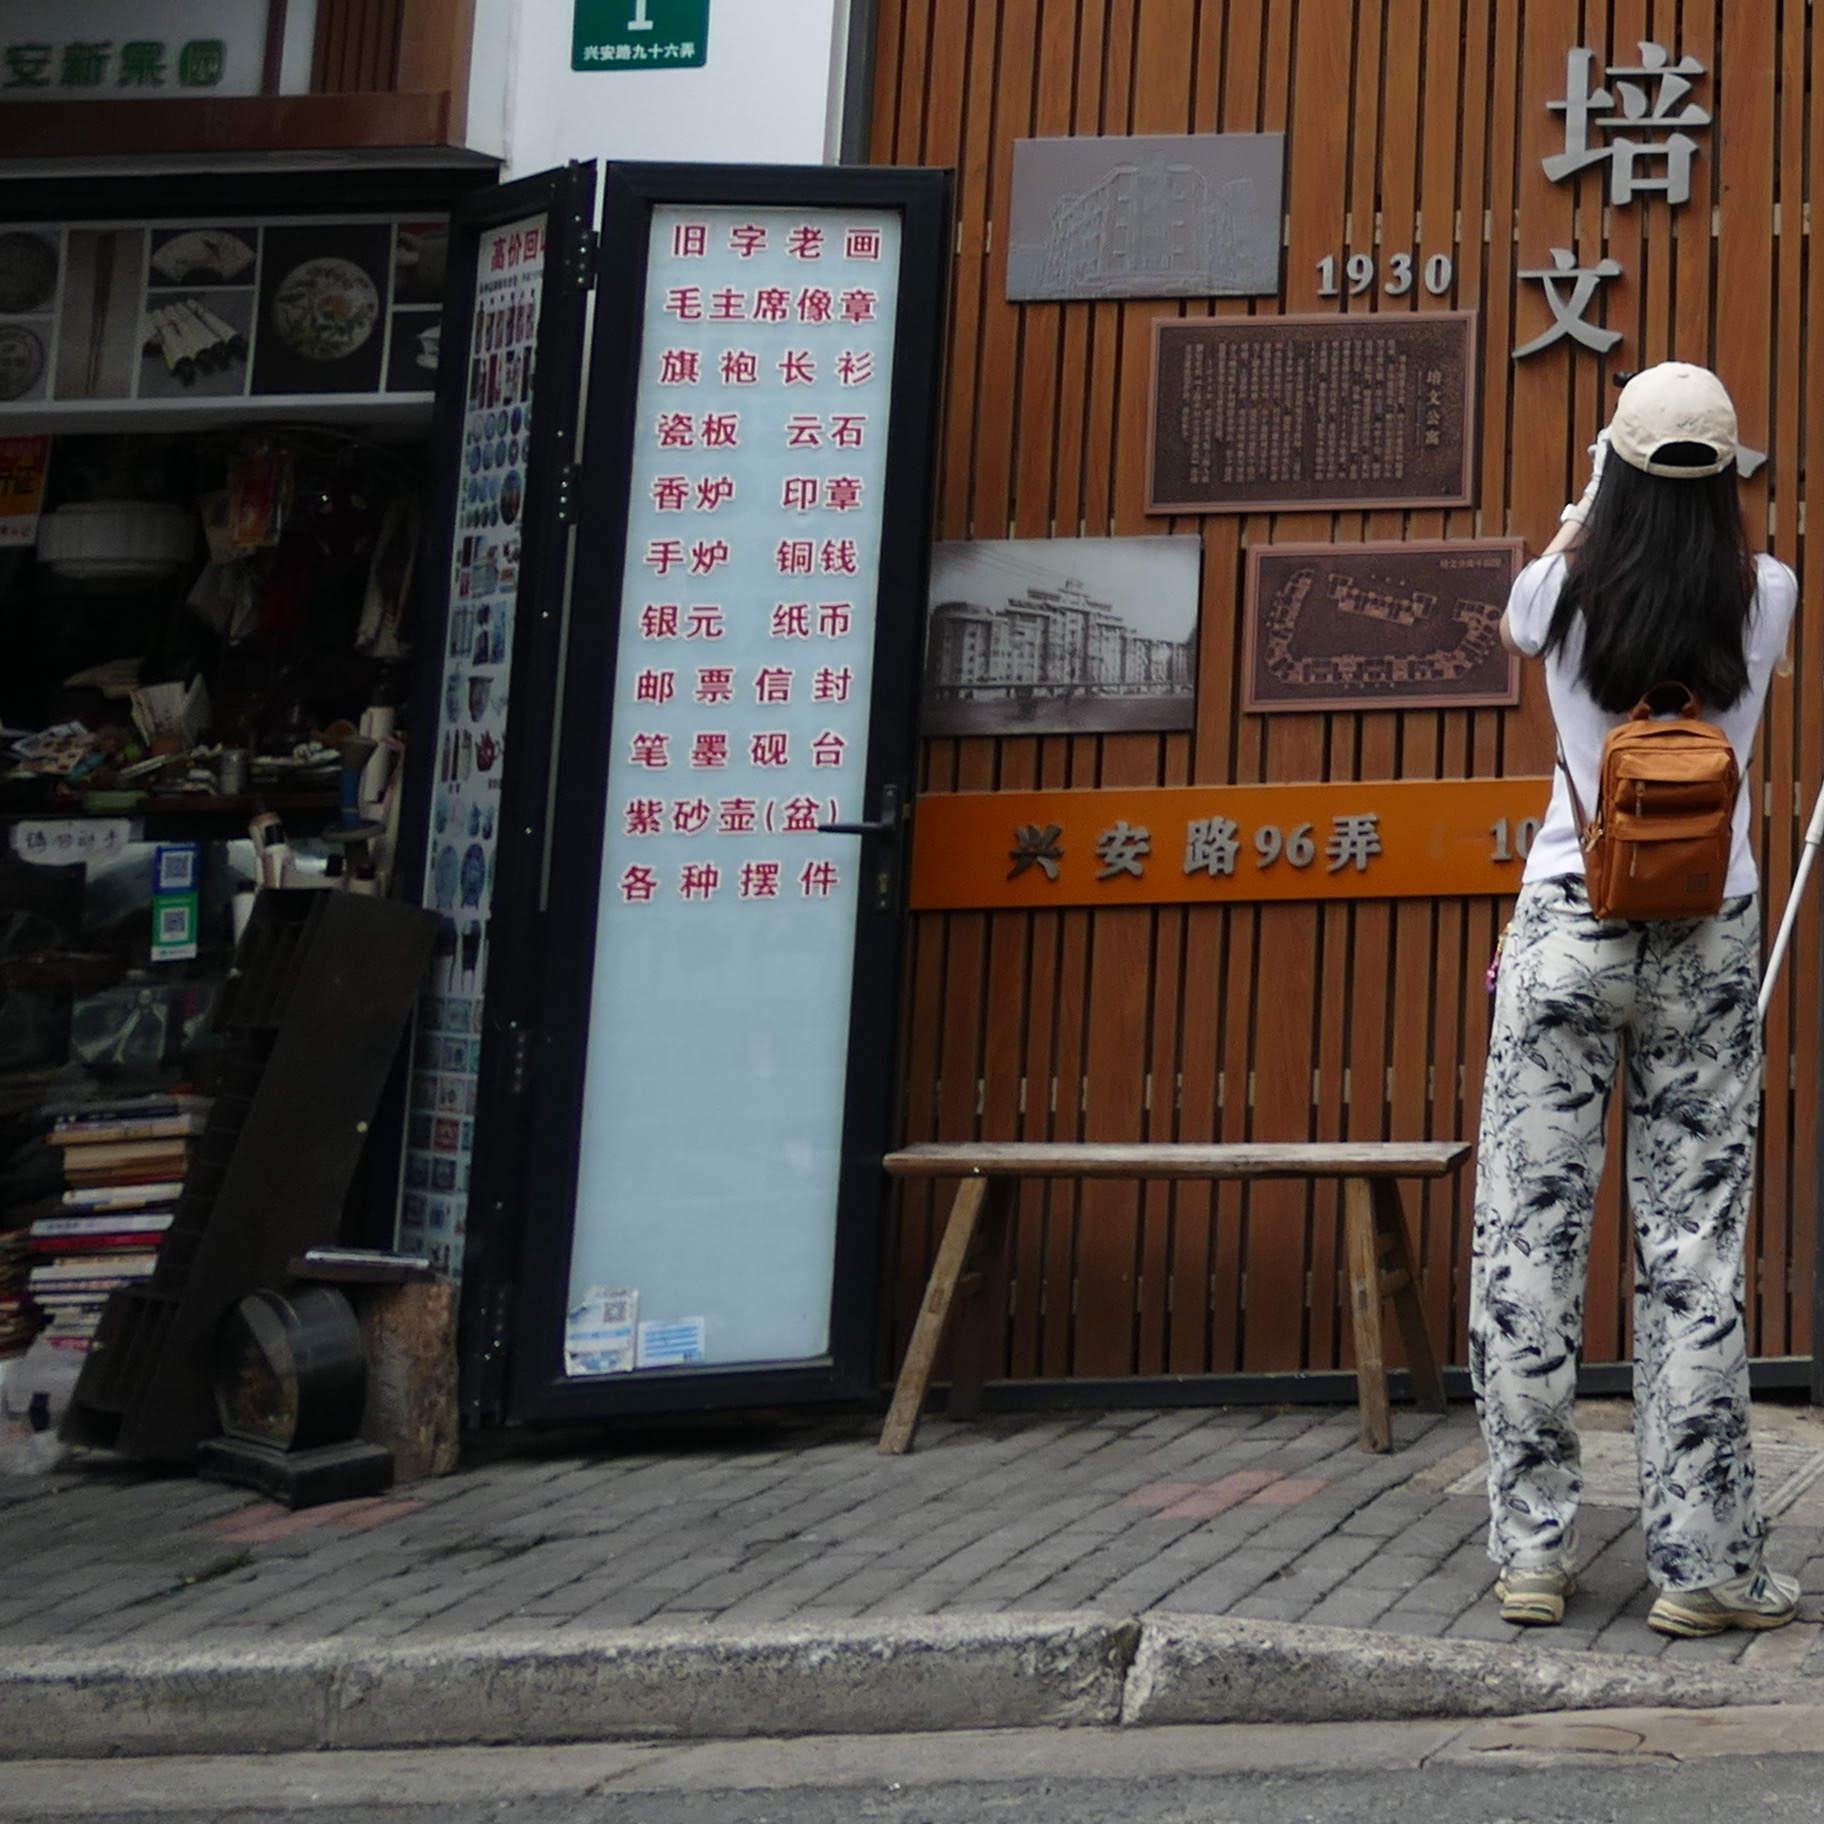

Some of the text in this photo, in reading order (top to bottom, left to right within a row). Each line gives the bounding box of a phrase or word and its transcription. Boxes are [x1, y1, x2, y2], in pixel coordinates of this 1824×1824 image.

[583, 41, 696, 62] 兴安路九十六弄
[673, 222, 882, 261] 旧字老画
[1316, 253, 1453, 296] 1930
[665, 284, 877, 324] 毛主席像章
[659, 348, 873, 385] 旗袍长衫
[657, 412, 867, 449] 瓷板 云石
[652, 475, 862, 511] 香炉 印章
[645, 539, 858, 576] 手炉 铜钱
[641, 602, 852, 639] 银元 纸币
[635, 667, 852, 704] 邮票信封
[630, 730, 847, 769] 笔墨砚台
[620, 861, 840, 902] 各种摆件
